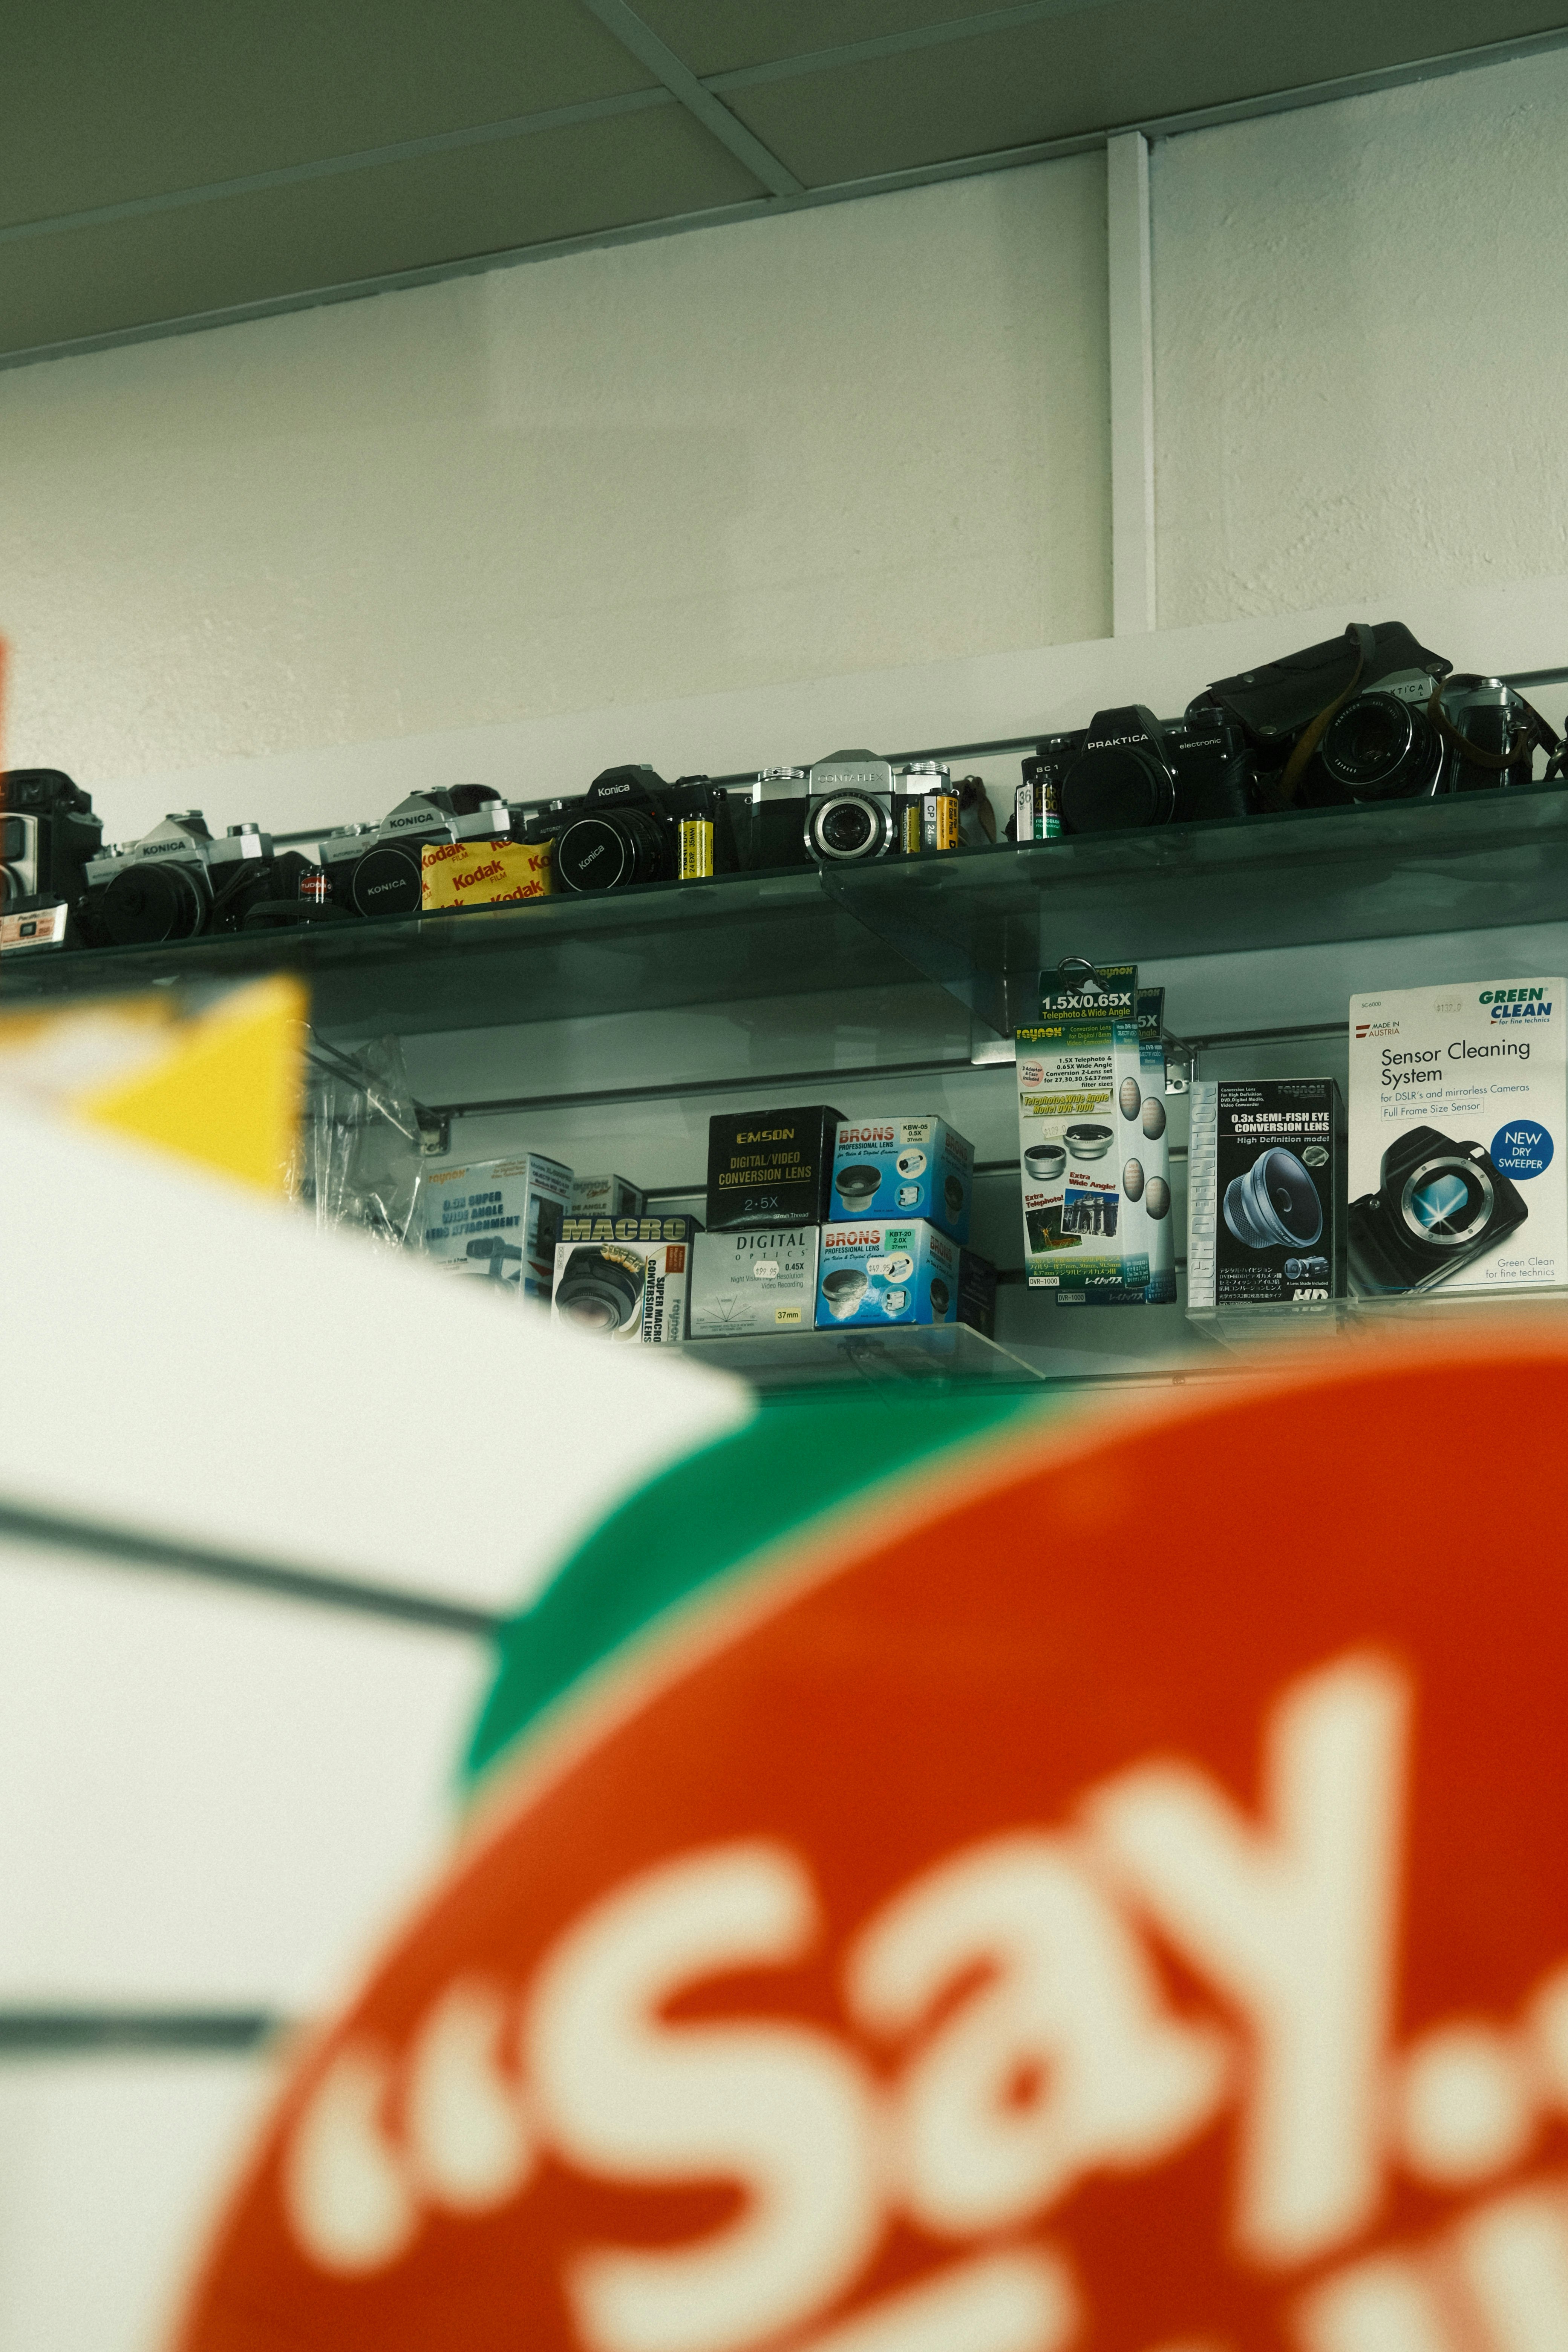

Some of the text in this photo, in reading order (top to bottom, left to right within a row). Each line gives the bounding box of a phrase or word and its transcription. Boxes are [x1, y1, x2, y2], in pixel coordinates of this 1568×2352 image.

[1390, 684, 1423, 695] KTICA
[1087, 733, 1149, 750] PRAKTICA
[1179, 738, 1221, 749] electronic
[818, 773, 883, 783] CONTAFLEX
[598, 784, 630, 796] Konica
[1019, 789, 1031, 805] 36
[927, 805, 935, 818] CP
[389, 813, 434, 828] KONICA
[143, 841, 186, 855] KONICA
[422, 843, 466, 871] Kodak
[452, 851, 469, 863] FILM
[578, 845, 605, 870] Konica
[452, 860, 505, 891] Kodak
[490, 871, 507, 884] FILM
[367, 879, 407, 896] KONICA
[490, 880, 544, 902] Kodak
[1042, 993, 1131, 1009] 1.5X/0.65X
[1479, 988, 1544, 1004] GREEN
[1043, 1010, 1080, 1020] Telephoto
[1109, 1008, 1130, 1018] Angle
[1491, 1003, 1552, 1018] CLEAN
[1017, 1027, 1062, 1043] raynox
[1369, 1028, 1400, 1037] AUSTRIA
[1381, 1039, 1530, 1066] Sensor Cleaning
[1381, 1069, 1442, 1090] System
[1381, 1093, 1393, 1102] for
[1426, 1088, 1442, 1098] and
[1446, 1085, 1487, 1097] mirrorless
[1490, 1084, 1530, 1093] Cameras
[1384, 1102, 1480, 1117] Full Frame Size Sensor
[1231, 1112, 1329, 1123] 0.3x SEMI-FISH EYE
[1235, 1122, 1329, 1133] CONVERSION LENS
[737, 1128, 794, 1144] EMSON
[839, 1127, 894, 1144] BRONS
[1237, 1136, 1257, 1145] High
[1505, 1132, 1542, 1145] NEW
[839, 1142, 878, 1151] PROFESSIONAL
[1512, 1147, 1532, 1156] DRY
[730, 1152, 800, 1168] DIGITAL/VIDEO
[1498, 1158, 1543, 1169] SWEEPER
[719, 1166, 811, 1185] CONVERSION LENS
[1070, 1171, 1090, 1180] Extra
[1069, 1178, 1116, 1190] Wide Angle!
[1025, 1193, 1044, 1202] Extra
[1026, 1194, 1064, 1208] Telephoto!
[1190, 1087, 1216, 1307] HIGH DEFINITION
[443, 1204, 504, 1224] WIDE ANGLE
[562, 1218, 686, 1240] MACRO
[737, 1233, 805, 1250] DIGITAL
[825, 1230, 880, 1248] BRONS
[825, 1246, 864, 1254] PROFESSIONAL
[1498, 1257, 1554, 1267] Green Clean
[756, 1267, 777, 1276] $99.95
[1486, 1268, 1555, 1278] for fine technics
[644, 1260, 656, 1343] CONVERSION LENS
[1292, 1289, 1329, 1301] HD
[653, 1277, 665, 1342] SUPER MACRO
